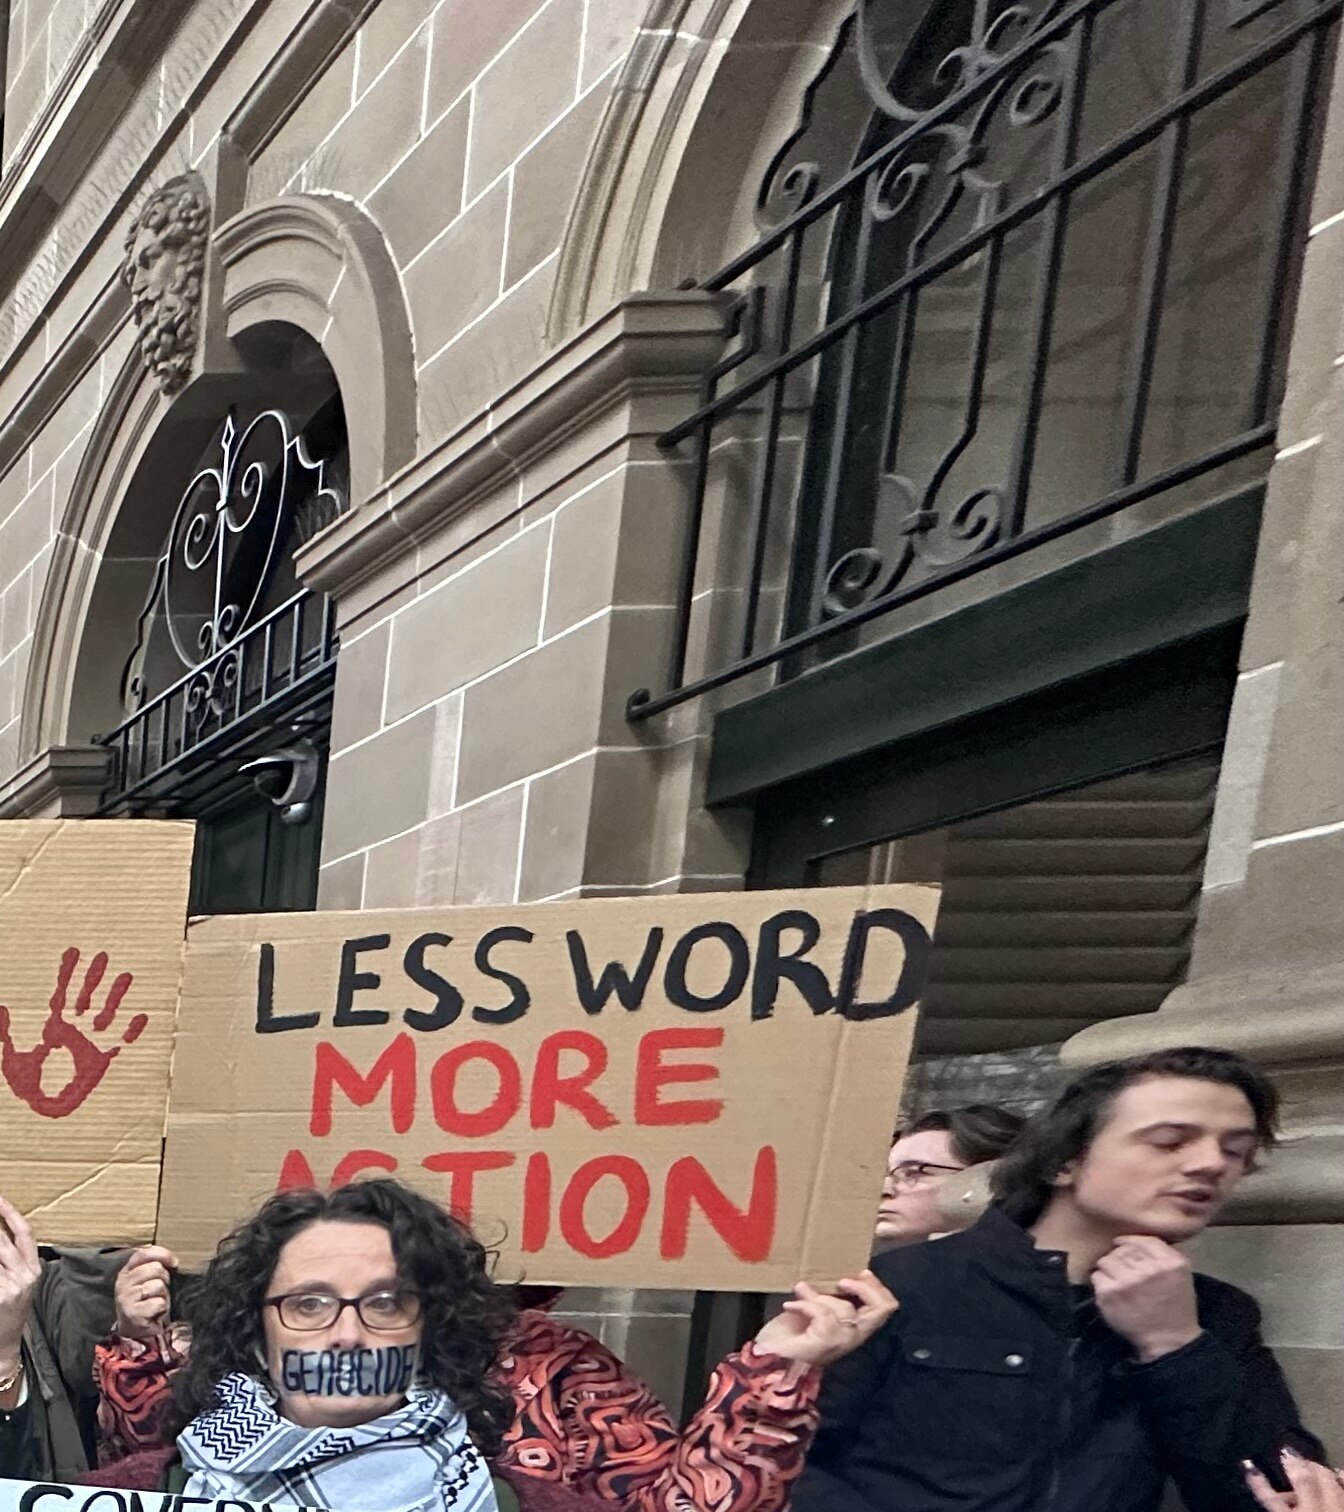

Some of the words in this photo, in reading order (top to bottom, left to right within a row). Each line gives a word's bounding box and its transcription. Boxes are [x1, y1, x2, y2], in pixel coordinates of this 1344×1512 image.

[255, 926, 535, 1033] LESS
[566, 908, 931, 1021] WORD
[309, 1027, 726, 1138] MORE
[282, 1345, 415, 1396] GENOCIDE
